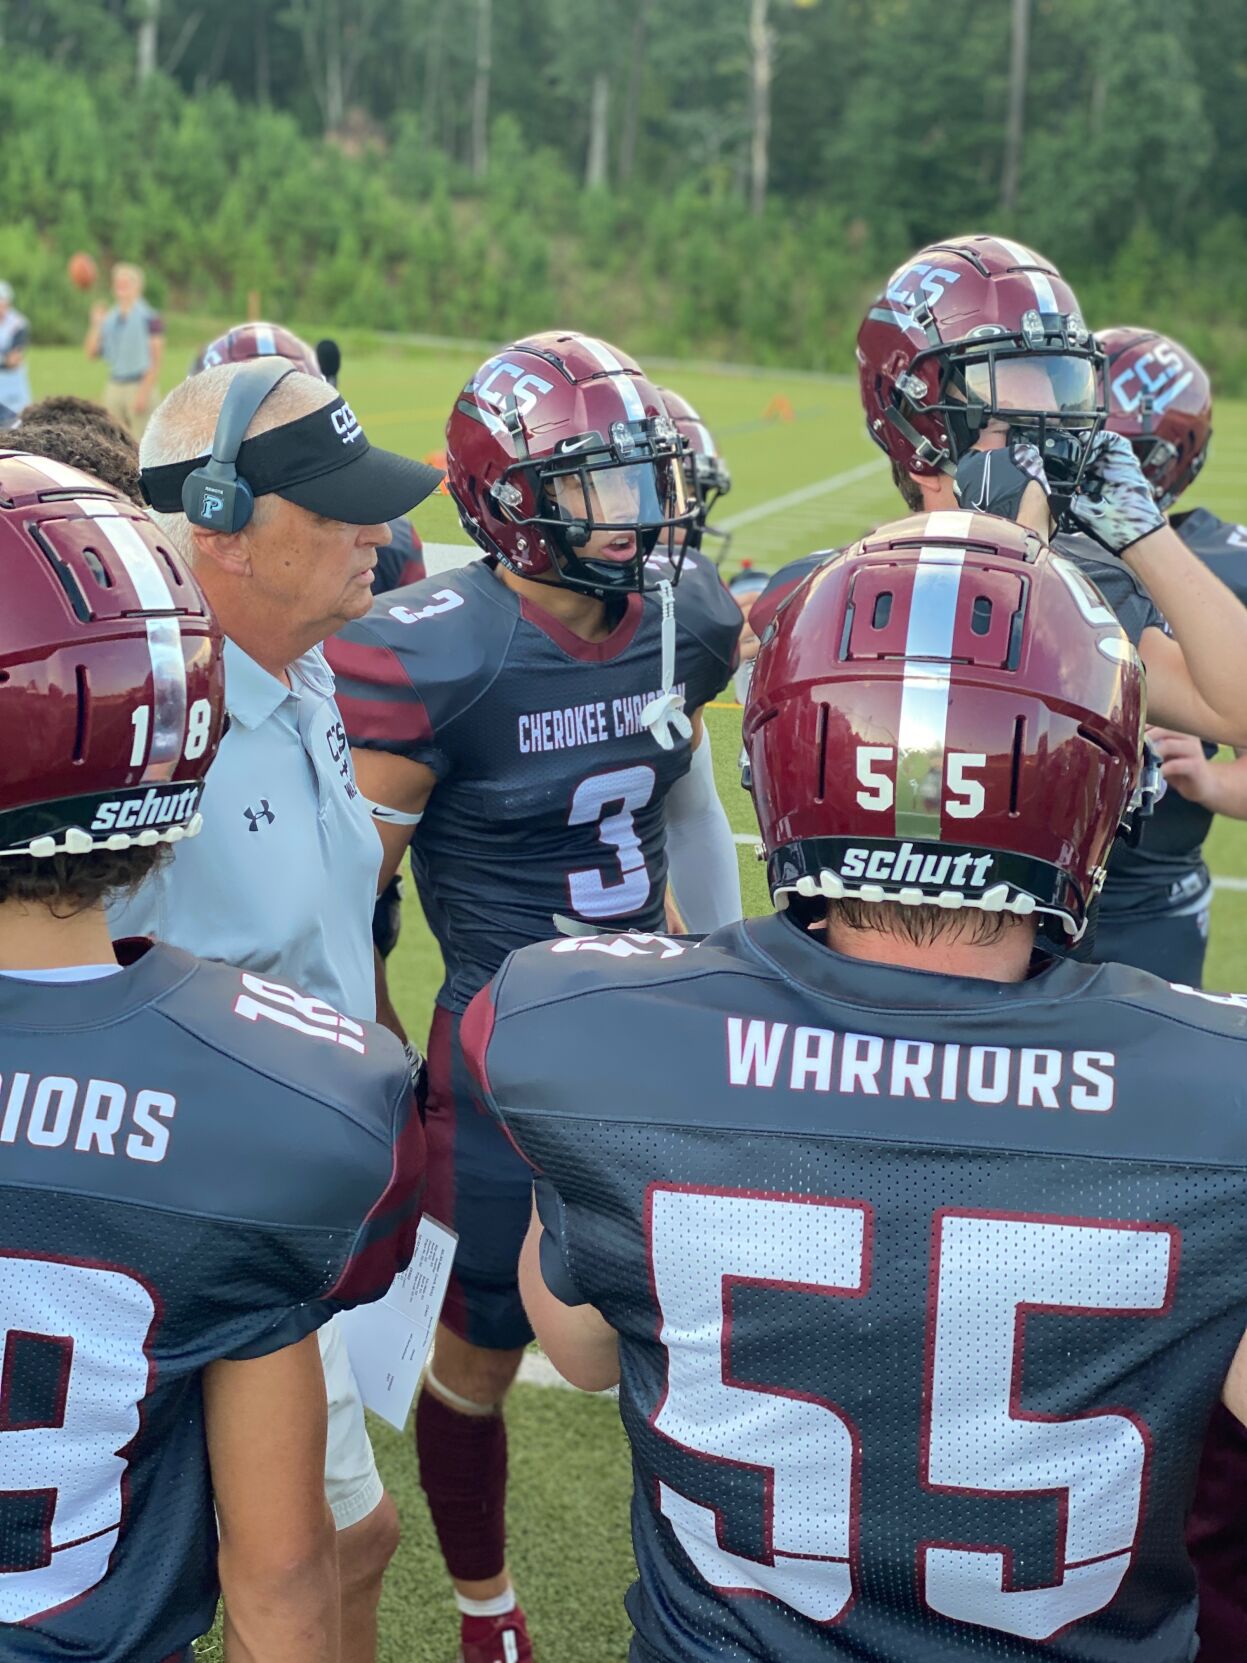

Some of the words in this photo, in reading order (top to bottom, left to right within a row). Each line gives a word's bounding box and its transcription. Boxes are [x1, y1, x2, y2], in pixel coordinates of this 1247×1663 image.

[1111, 343, 1184, 413] CCS
[200, 493, 224, 519] P
[518, 702, 609, 754] CHEROKEE
[90, 787, 198, 831] schutt
[565, 763, 657, 919] 3
[840, 842, 995, 888] schutt
[726, 1016, 1116, 1112] WARRIORS
[0, 1070, 177, 1164] IORS
[643, 1177, 1180, 1643] 55
